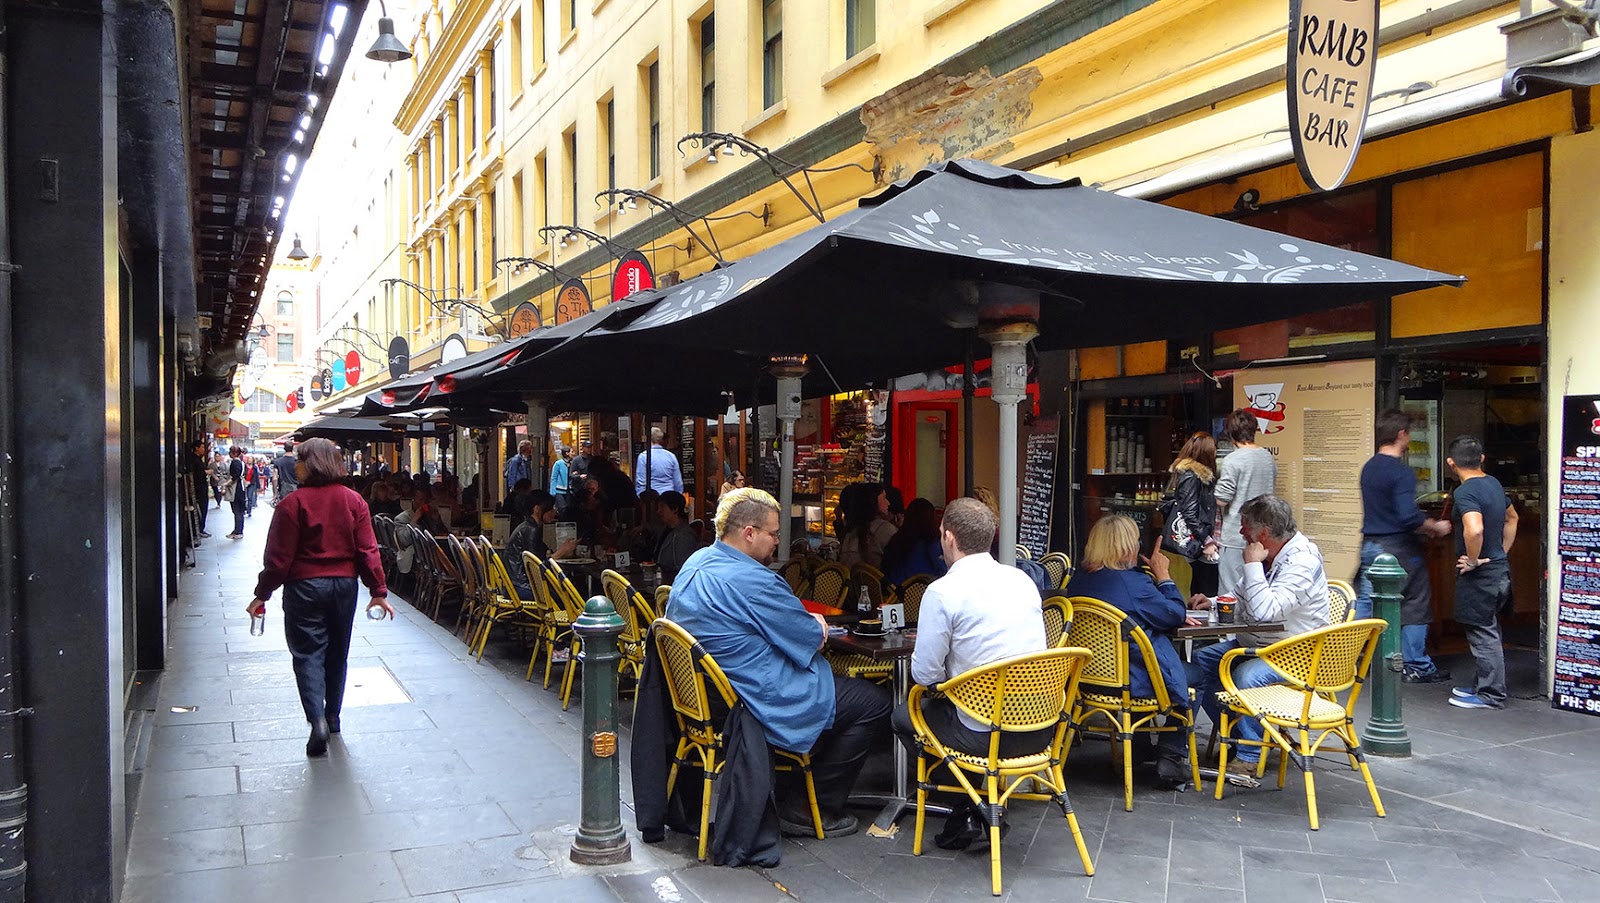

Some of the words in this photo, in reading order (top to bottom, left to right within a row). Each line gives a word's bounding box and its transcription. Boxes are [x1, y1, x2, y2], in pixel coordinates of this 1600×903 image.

[1299, 14, 1368, 67] RMB
[1301, 67, 1358, 109] CAFE
[1303, 112, 1349, 149] BAR
[1000, 238, 1058, 256] true
[1063, 248, 1093, 260] to
[1099, 249, 1145, 263] the
[1144, 251, 1220, 266] bean
[627, 267, 635, 296] ondo
[619, 554, 626, 565] 2
[889, 608, 898, 624] 6
[1560, 694, 1584, 709] PH:
